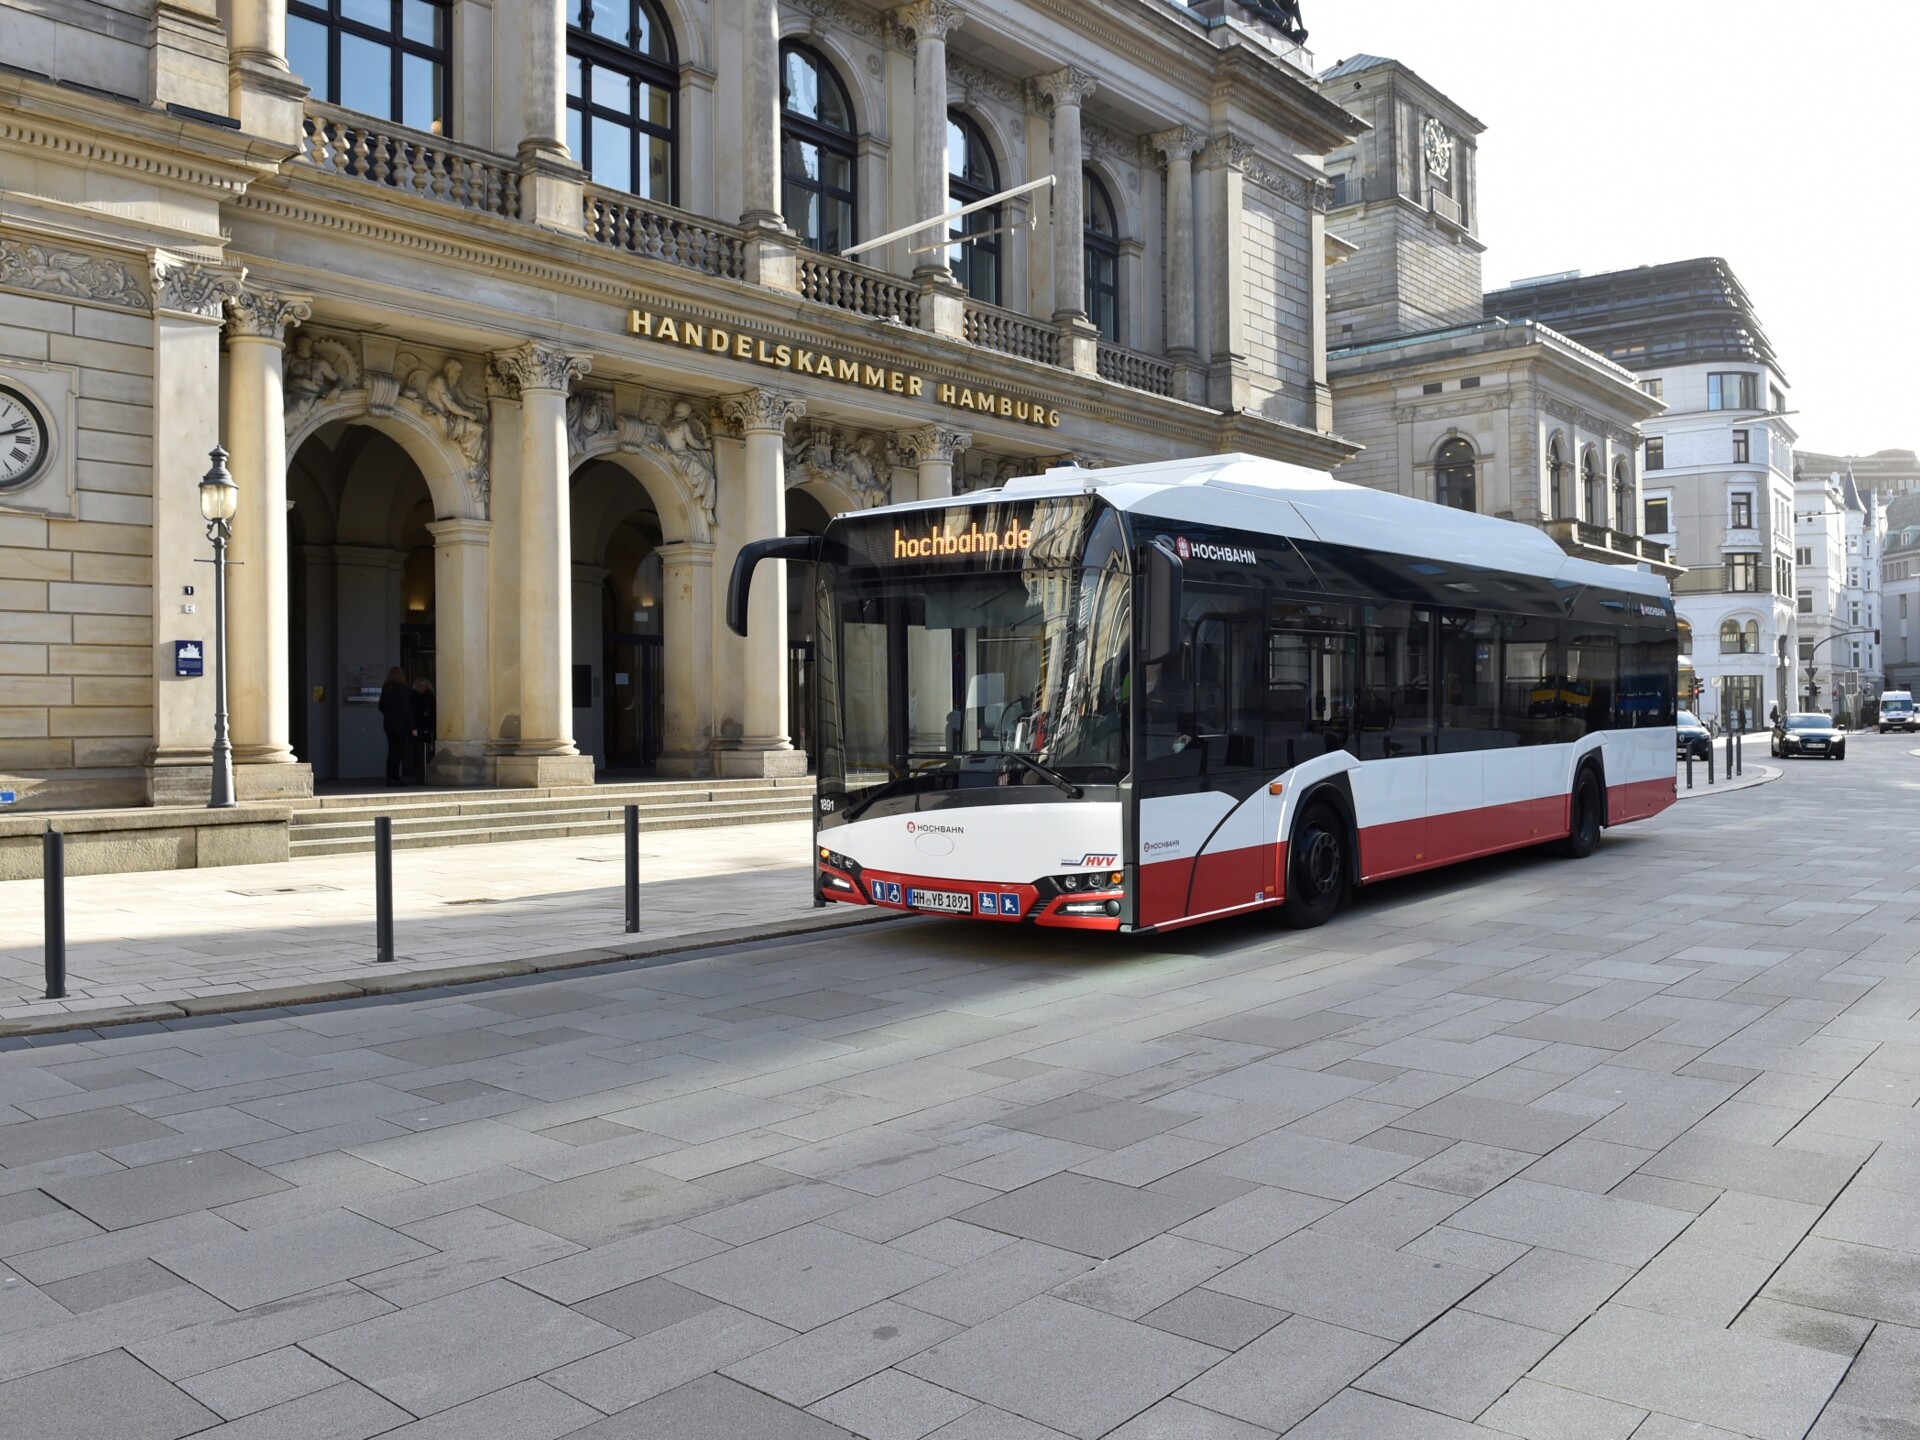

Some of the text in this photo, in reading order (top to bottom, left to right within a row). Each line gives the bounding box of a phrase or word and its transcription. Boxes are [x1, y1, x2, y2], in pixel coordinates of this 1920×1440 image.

[628, 309, 1060, 428] HANDELSKAMMER HAMBURG
[894, 519, 1032, 558] hochbahn.de
[1190, 542, 1257, 565] HOCHBAHN
[820, 798, 835, 812] 1891
[917, 824, 964, 834] HOCHBAHN
[1150, 839, 1180, 850] HOCHBAHN
[1085, 856, 1116, 867] HVV
[912, 890, 970, 910] HH YB 1891
